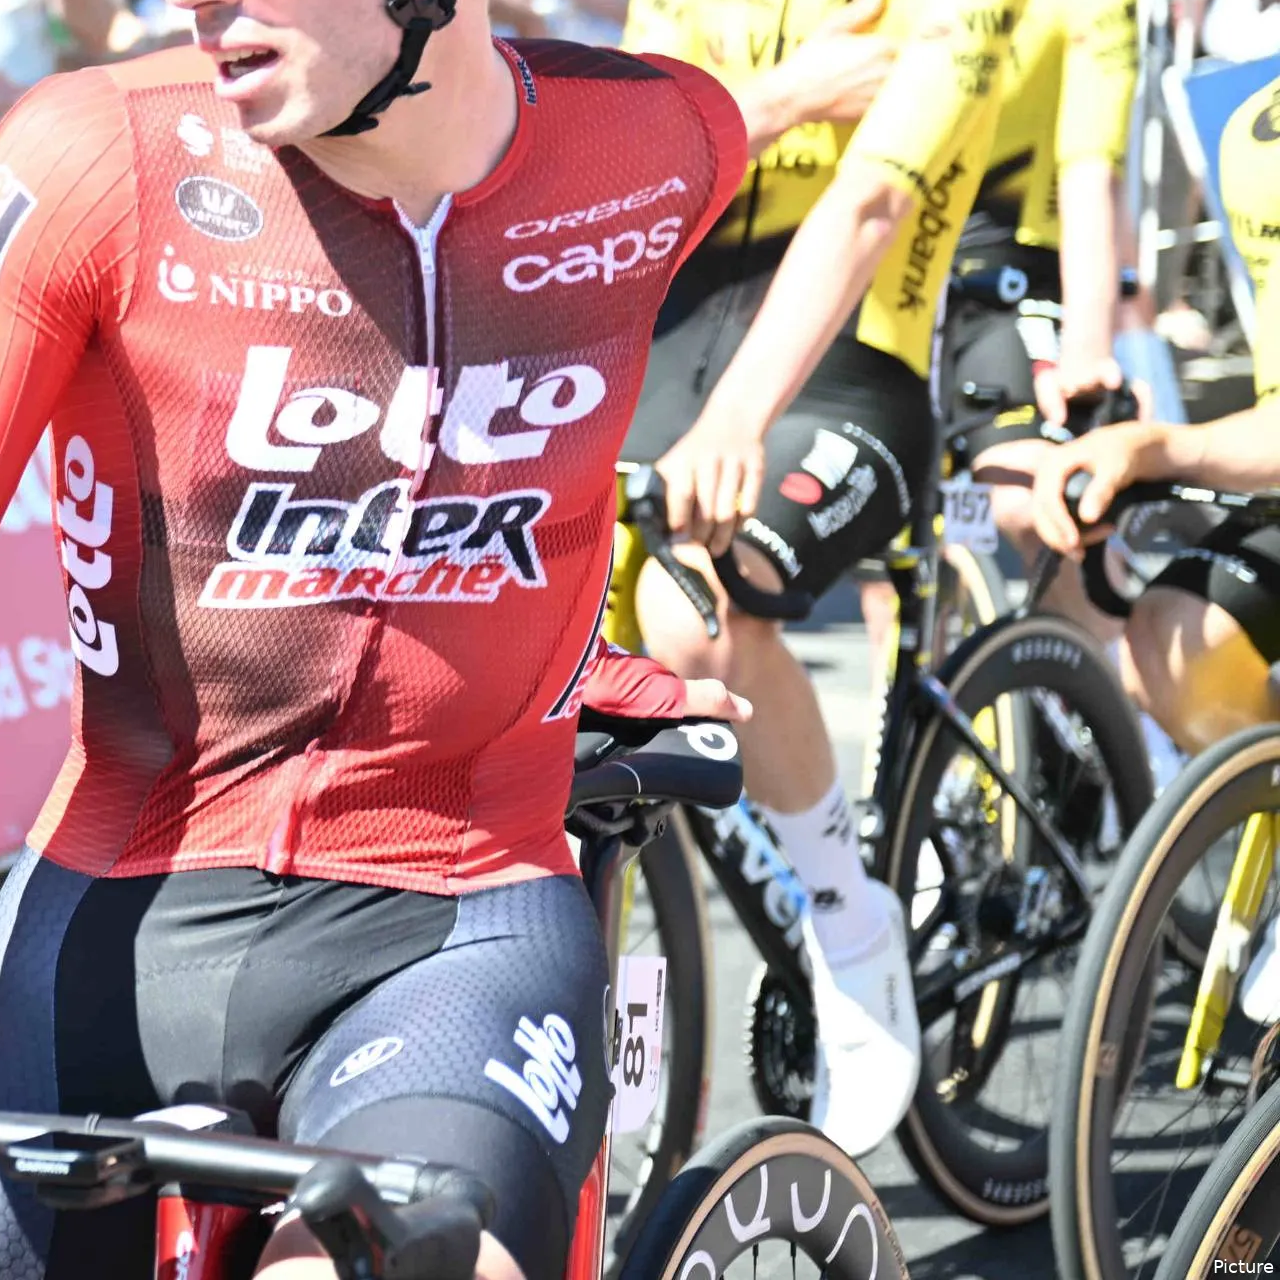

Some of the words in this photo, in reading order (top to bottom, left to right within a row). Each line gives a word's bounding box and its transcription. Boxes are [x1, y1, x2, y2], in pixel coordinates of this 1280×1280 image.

[503, 175, 687, 240] ORBEA
[209, 274, 353, 317] NIPPO
[502, 216, 683, 293] caps
[226, 345, 607, 472] lotto
[57, 434, 120, 677] lotto
[483, 1013, 583, 1144] lotto
[622, 1002, 649, 1088] 81
